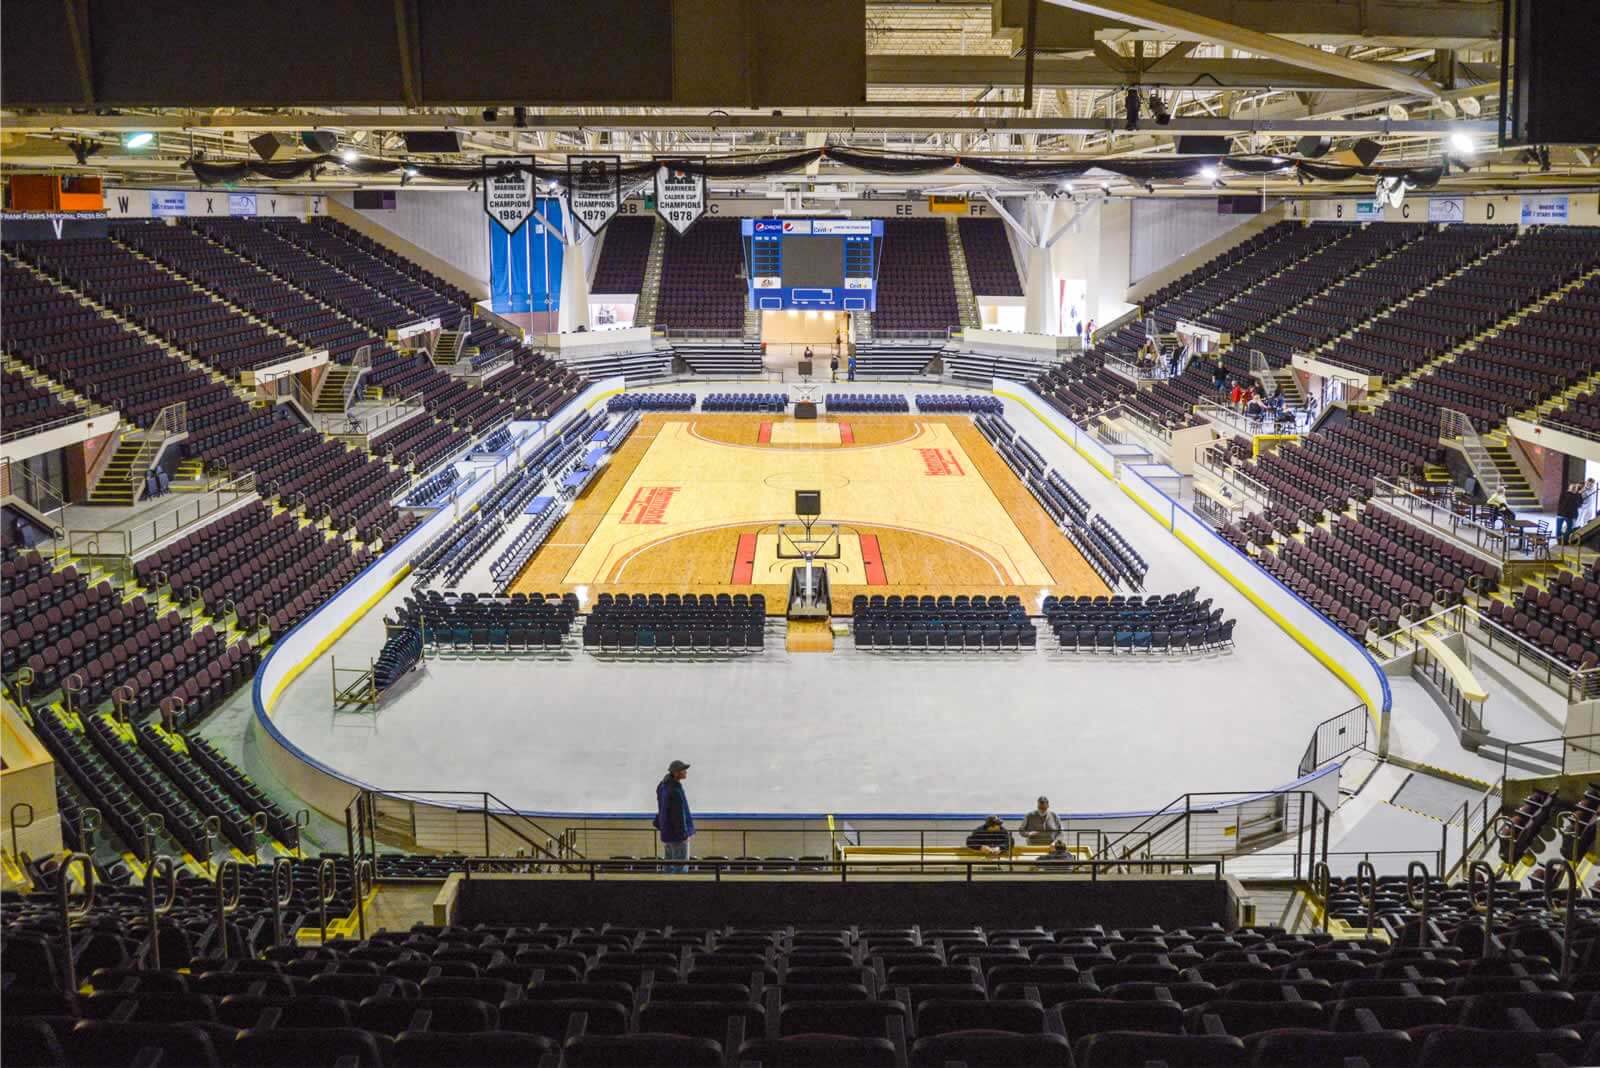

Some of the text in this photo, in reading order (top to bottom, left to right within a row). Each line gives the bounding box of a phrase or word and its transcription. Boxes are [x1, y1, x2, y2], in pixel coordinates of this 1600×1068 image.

[118, 196, 129, 213] W
[207, 198, 213, 213] X
[270, 199, 276, 213] Y
[896, 205, 913, 215] EE
[970, 205, 987, 215] FF
[1293, 205, 1297, 217] A
[1402, 204, 1410, 218] C
[1487, 203, 1495, 219] D
[499, 211, 522, 219] 1984
[583, 211, 606, 220] 1979
[670, 211, 692, 220] 1978
[1337, 205, 1342, 218] B
[53, 219, 63, 239] V
